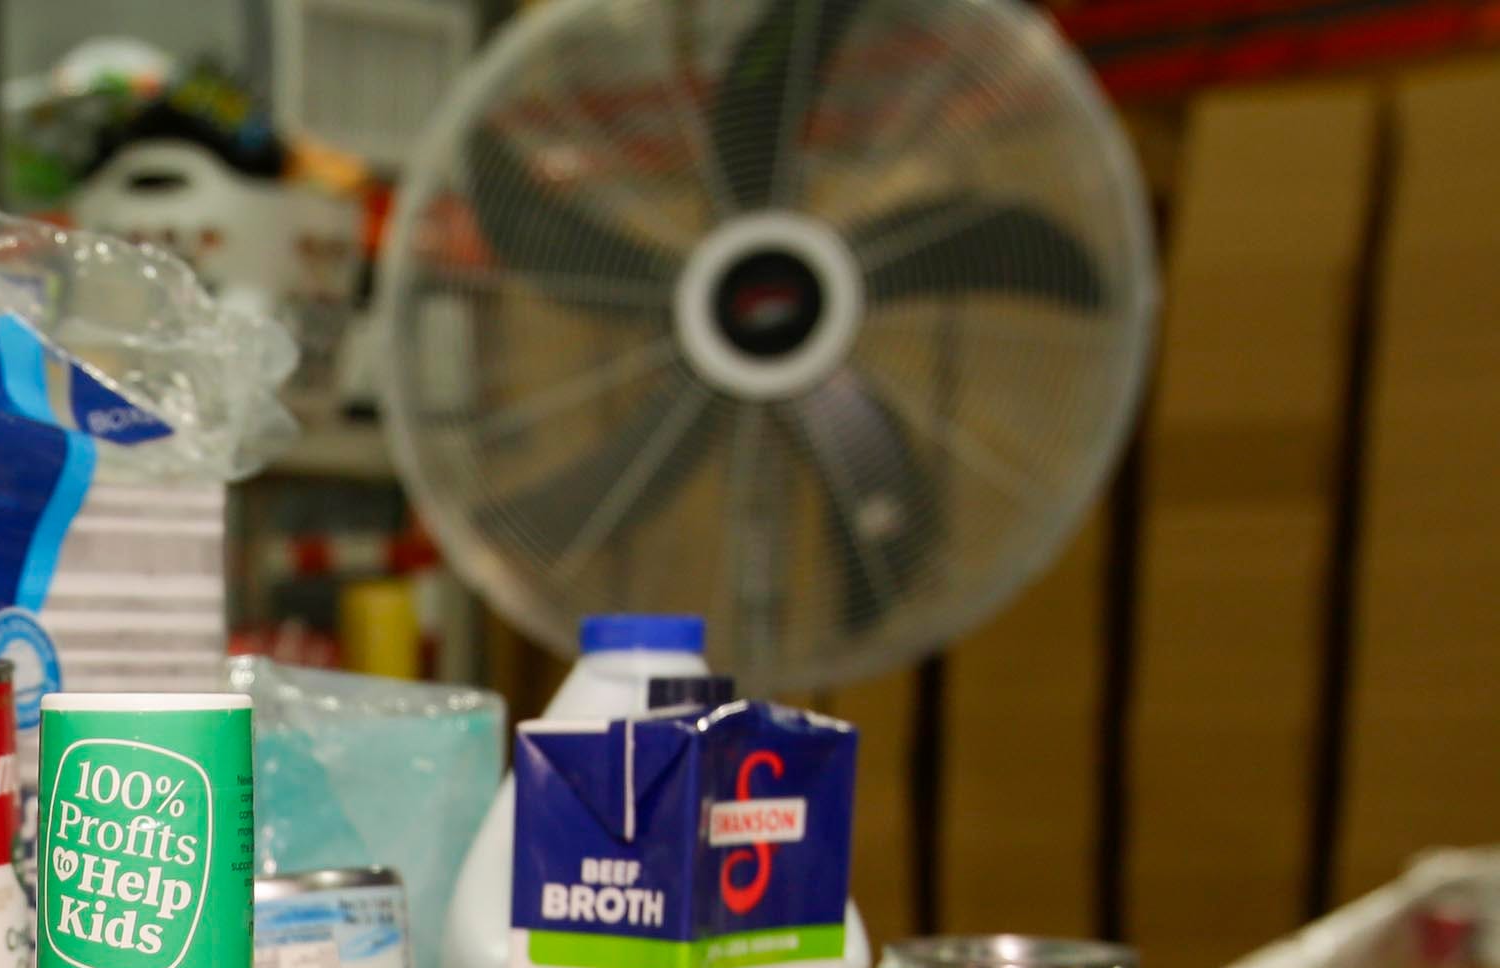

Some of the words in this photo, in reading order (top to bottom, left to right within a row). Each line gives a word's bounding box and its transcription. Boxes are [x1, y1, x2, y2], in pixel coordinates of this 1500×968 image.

[75, 761, 185, 818] 100%
[56, 800, 198, 865] Profits
[713, 810, 797, 837] SWANSON
[57, 854, 73, 873] to
[77, 853, 192, 920] Help
[581, 857, 642, 886] BEEF
[56, 894, 164, 955] Kids
[541, 881, 665, 928] BROTH
